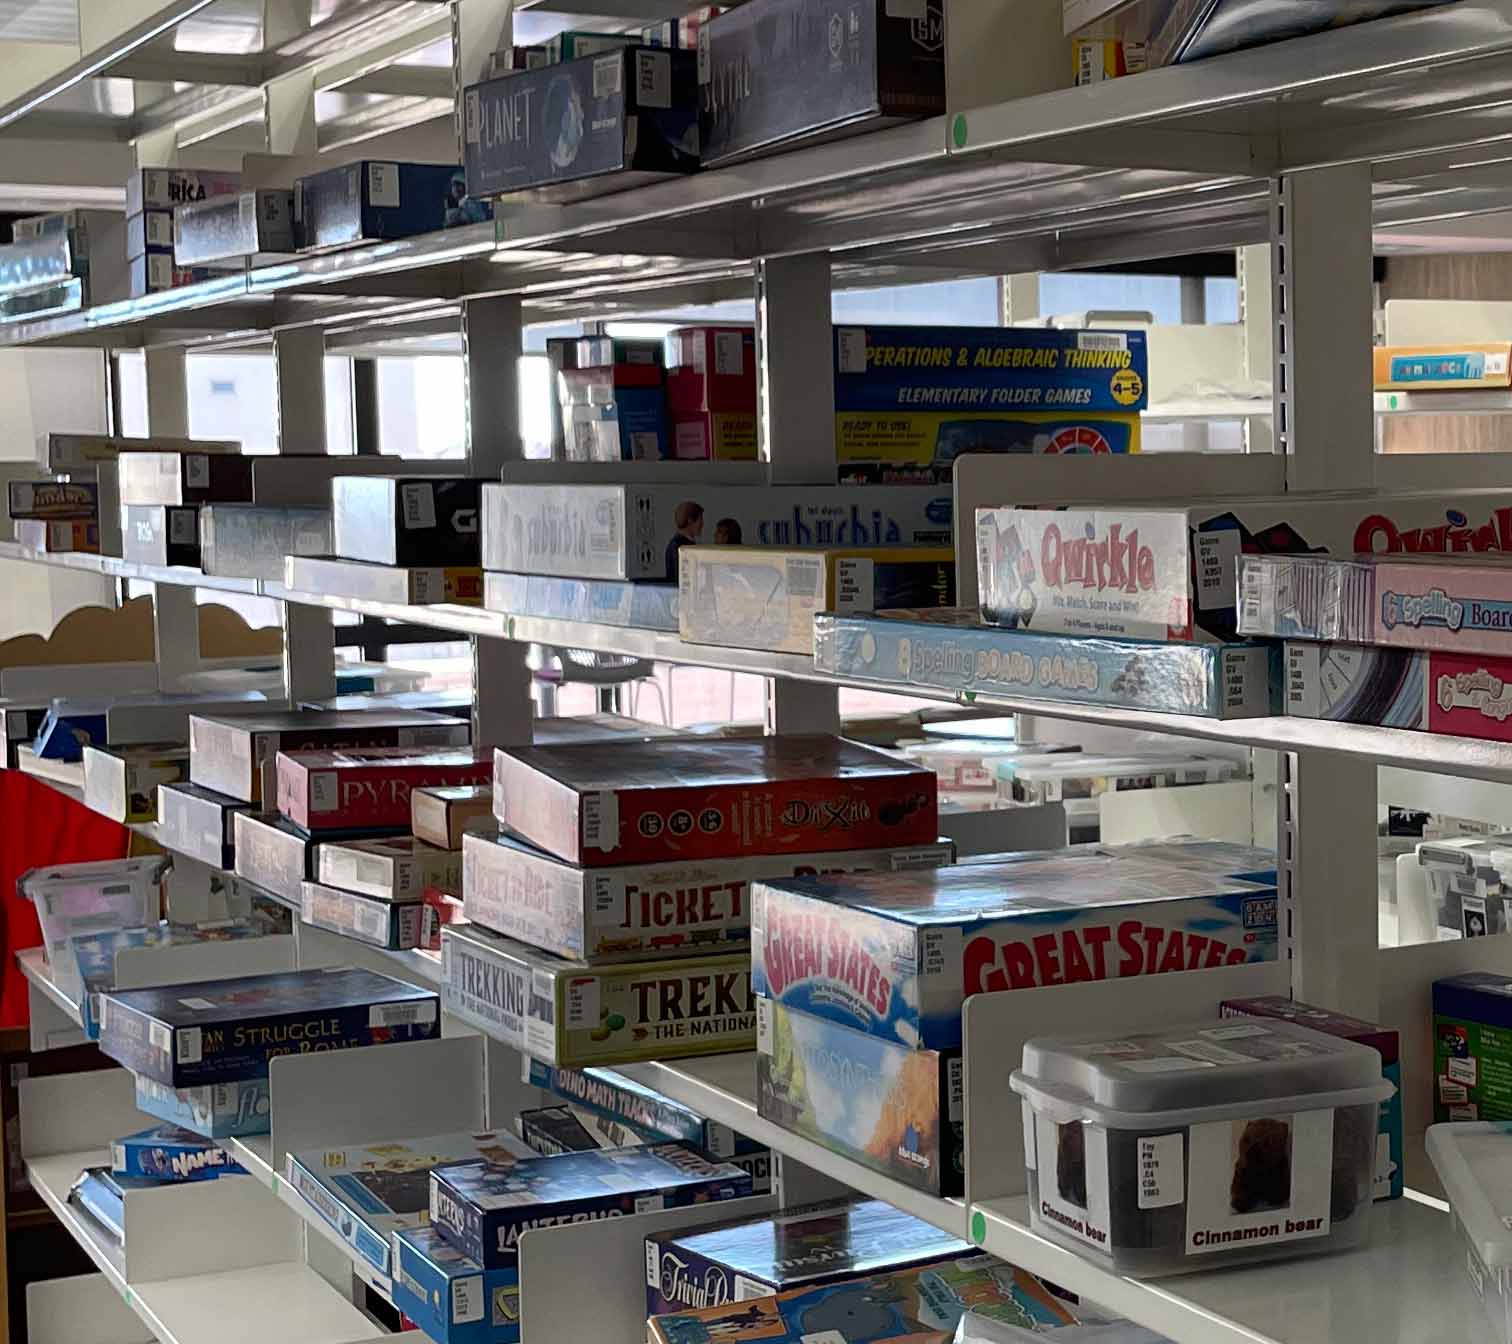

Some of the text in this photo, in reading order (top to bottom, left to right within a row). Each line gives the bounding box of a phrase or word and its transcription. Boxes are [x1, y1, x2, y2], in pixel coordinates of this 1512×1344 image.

[479, 87, 537, 150] PLANET
[864, 346, 1132, 369] PERATIONS & ALGEBRAIC THINKING
[896, 386, 1092, 404] ELEMENTARY FOLDER GAMES
[1112, 382, 1140, 397] 4-5
[757, 504, 902, 545] suburbia
[1040, 522, 1155, 594] Qwirkle
[1402, 587, 1464, 631] Spelling
[619, 880, 747, 929] TICKET
[763, 907, 893, 1019] GREAT STATES
[962, 919, 1248, 996] GREAT STATES
[462, 952, 525, 1018] TREKKING
[232, 1019, 342, 1047] STRUGGLE
[654, 1020, 686, 1041] THE
[559, 1069, 589, 1099] DINO
[588, 1080, 618, 1110] MATH
[1142, 1142, 1155, 1152] Toy
[1040, 1199, 1107, 1245] Cinnamon bear
[1192, 1216, 1324, 1247] Cinnamon bear
